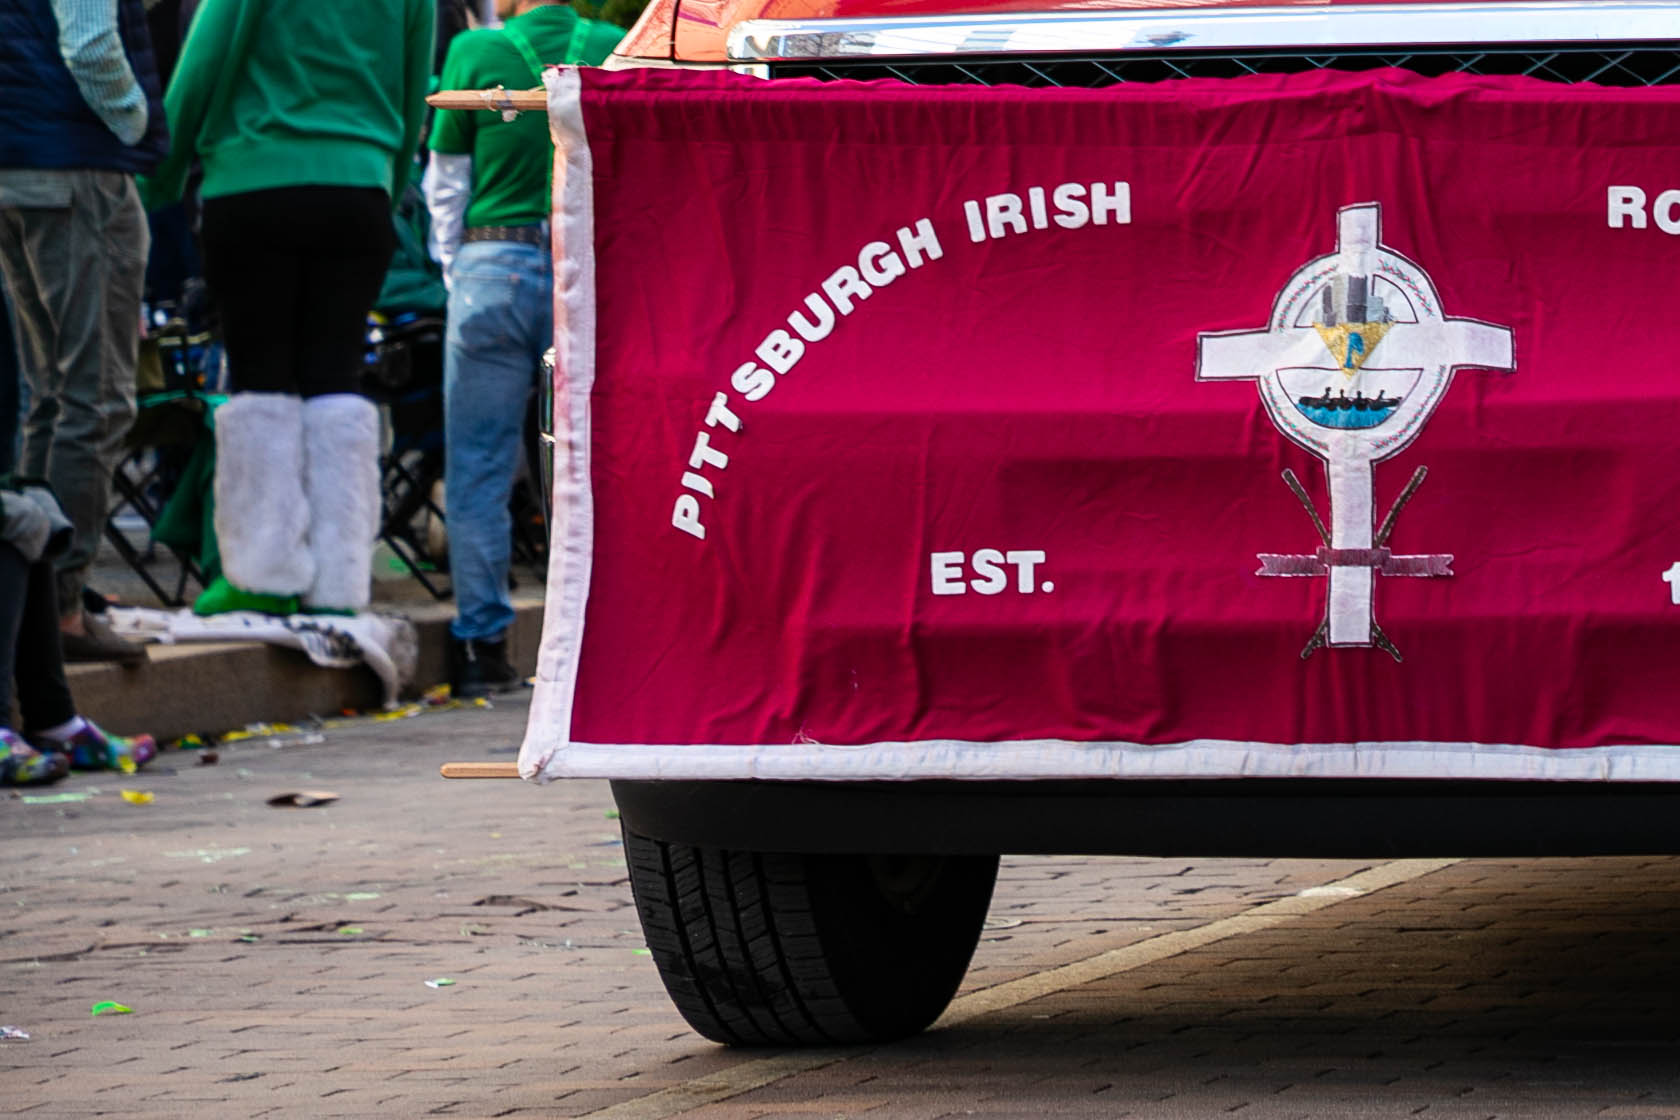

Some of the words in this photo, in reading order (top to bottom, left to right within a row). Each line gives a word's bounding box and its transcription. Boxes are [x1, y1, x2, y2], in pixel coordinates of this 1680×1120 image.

[671, 218, 943, 540] PITTSBURGH
[963, 181, 1131, 243] IRISH
[930, 548, 1055, 595] EST.
